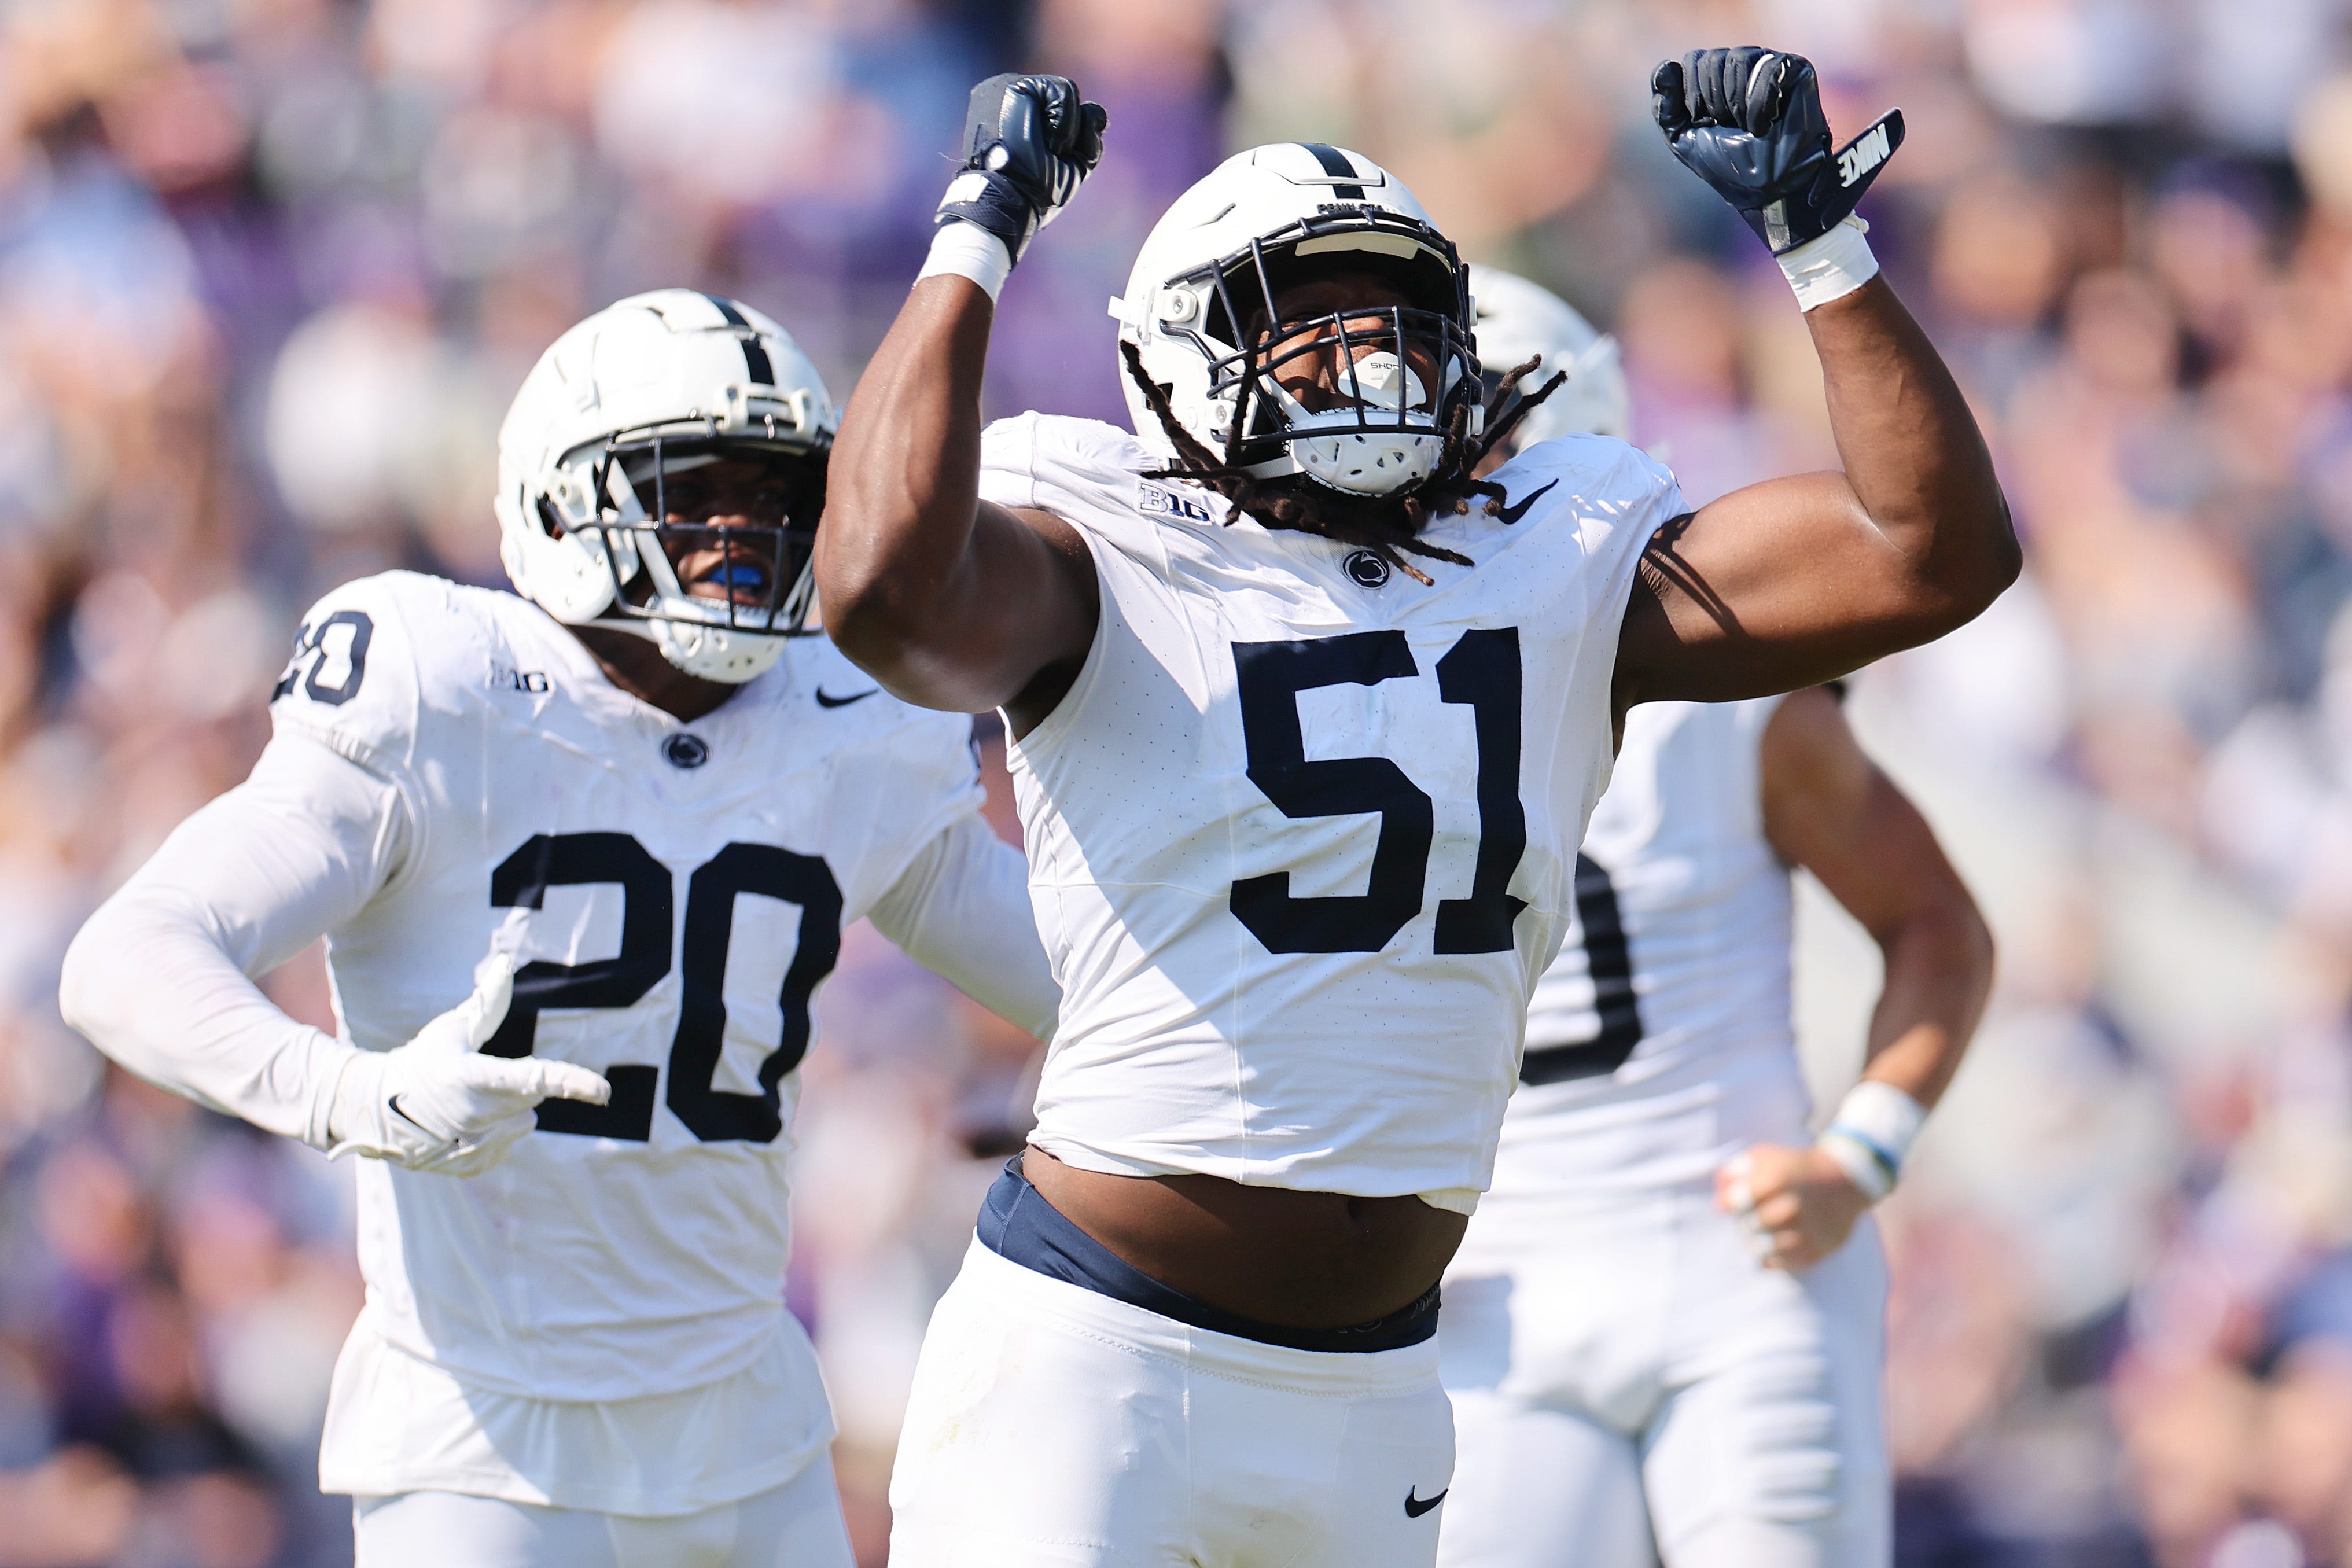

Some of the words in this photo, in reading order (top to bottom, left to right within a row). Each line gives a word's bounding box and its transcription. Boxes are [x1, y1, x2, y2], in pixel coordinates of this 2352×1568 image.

[1836, 123, 1890, 187] NIKE
[1230, 627, 1529, 955] 51
[478, 831, 843, 1143] 20
